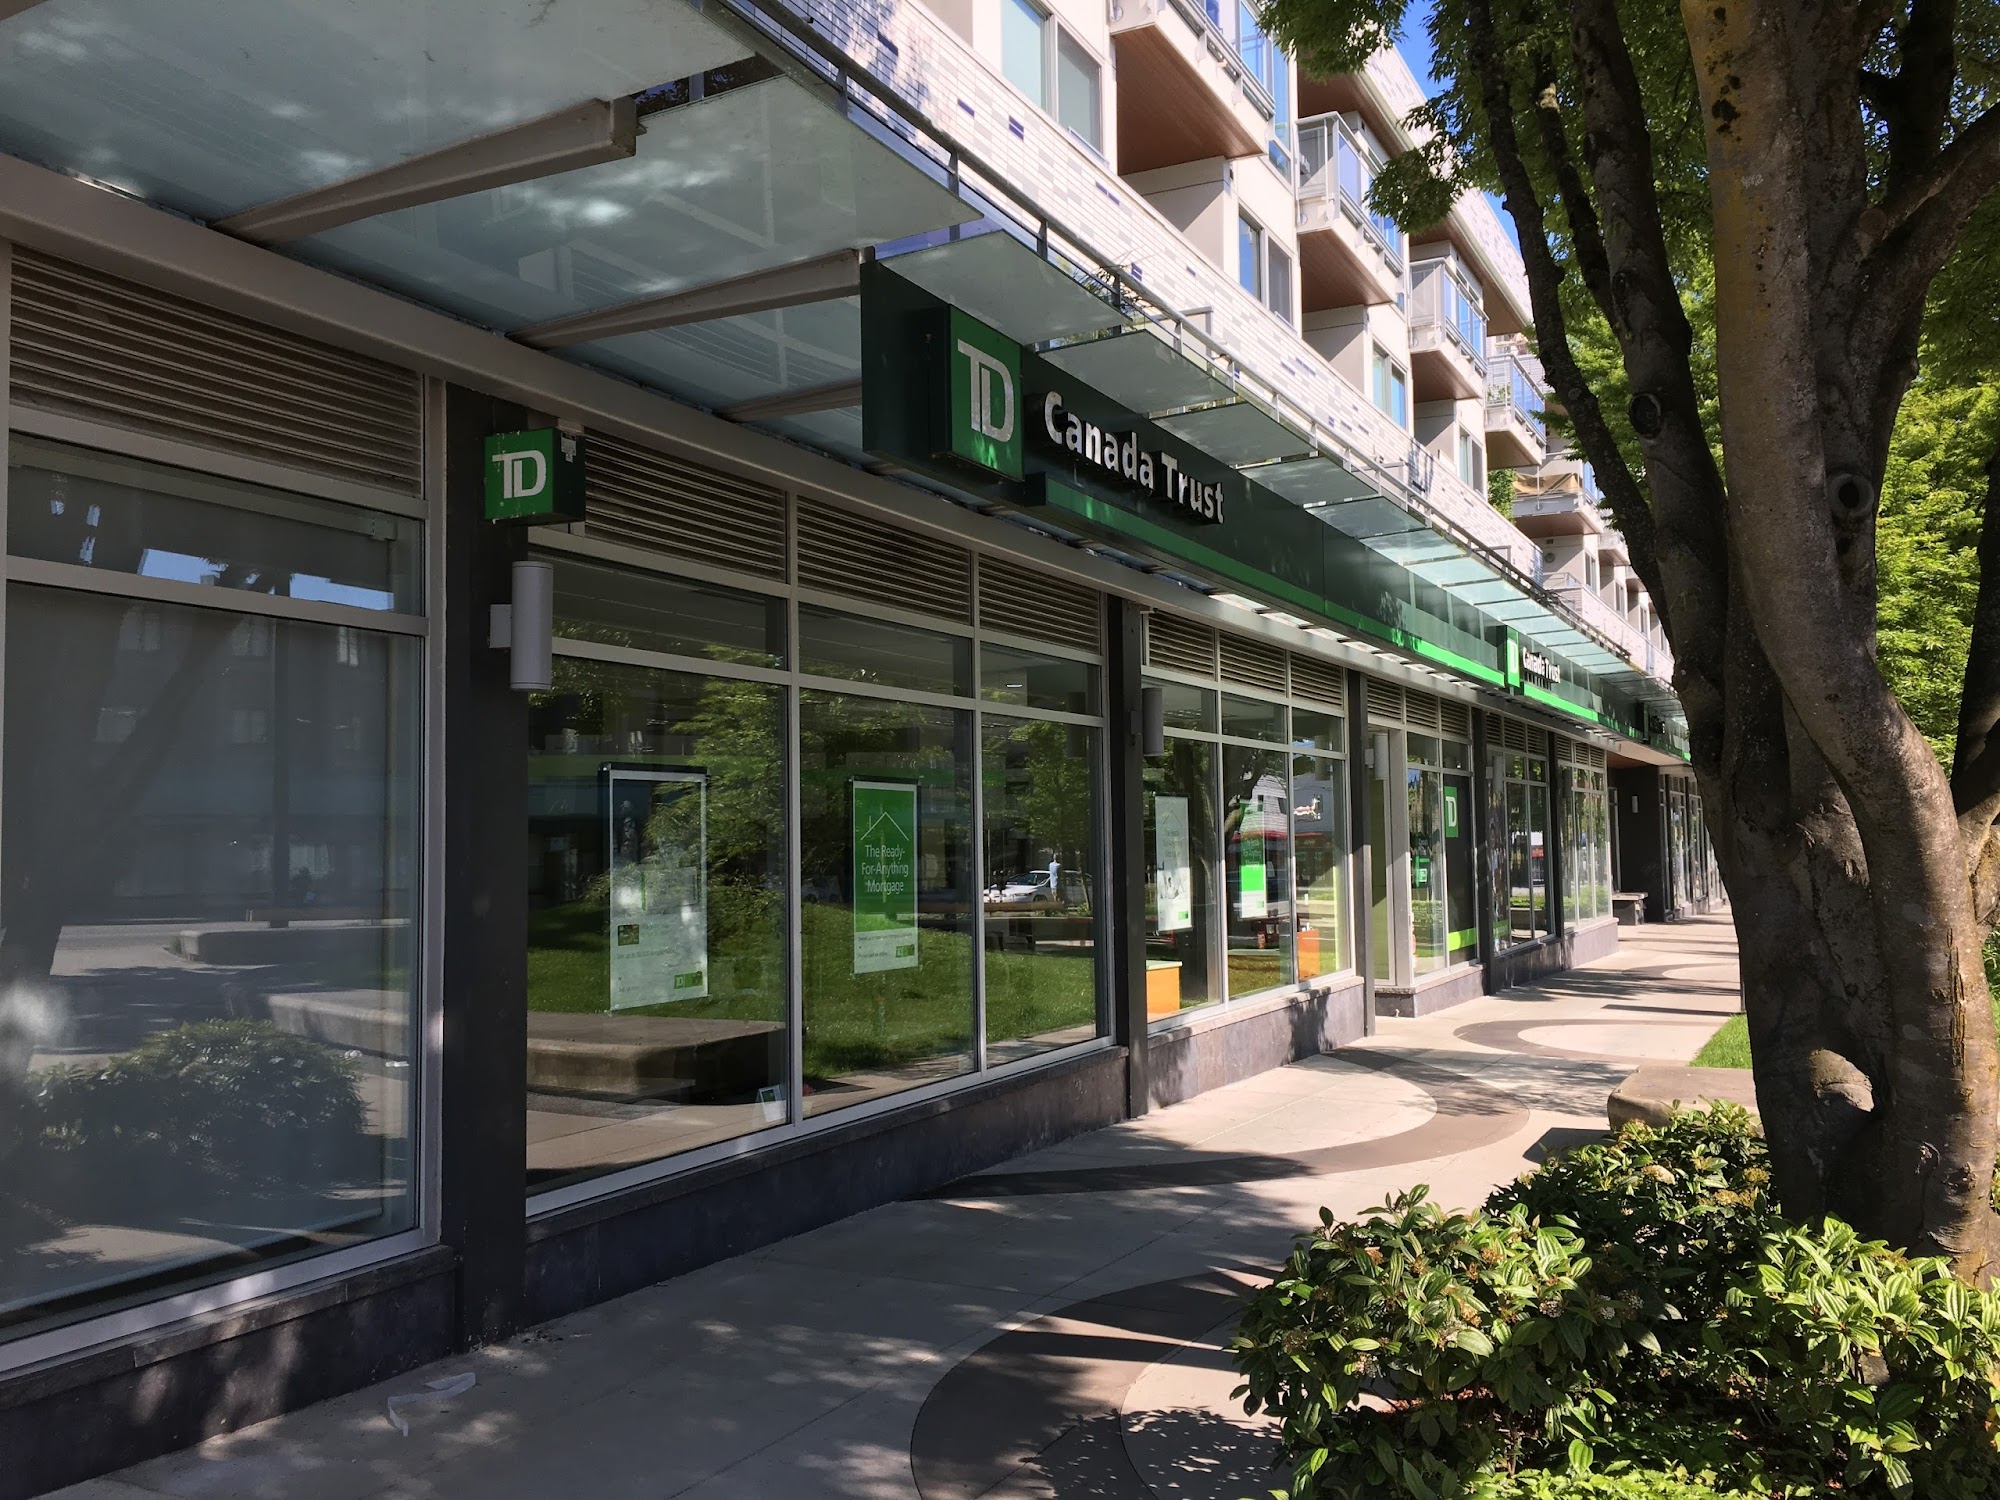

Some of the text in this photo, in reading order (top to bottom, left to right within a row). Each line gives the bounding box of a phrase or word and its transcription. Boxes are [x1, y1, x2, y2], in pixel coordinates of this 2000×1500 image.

[957, 338, 1224, 524] TD Canada Trust
[492, 450, 547, 499] TD
[1522, 646, 1545, 677] Canada
[1545, 657, 1561, 684] Trust
[1446, 796, 1456, 827] TD
[865, 844, 906, 860] The Ready-
[861, 862, 909, 877] For-Anything
[867, 879, 904, 895] Mortgage
